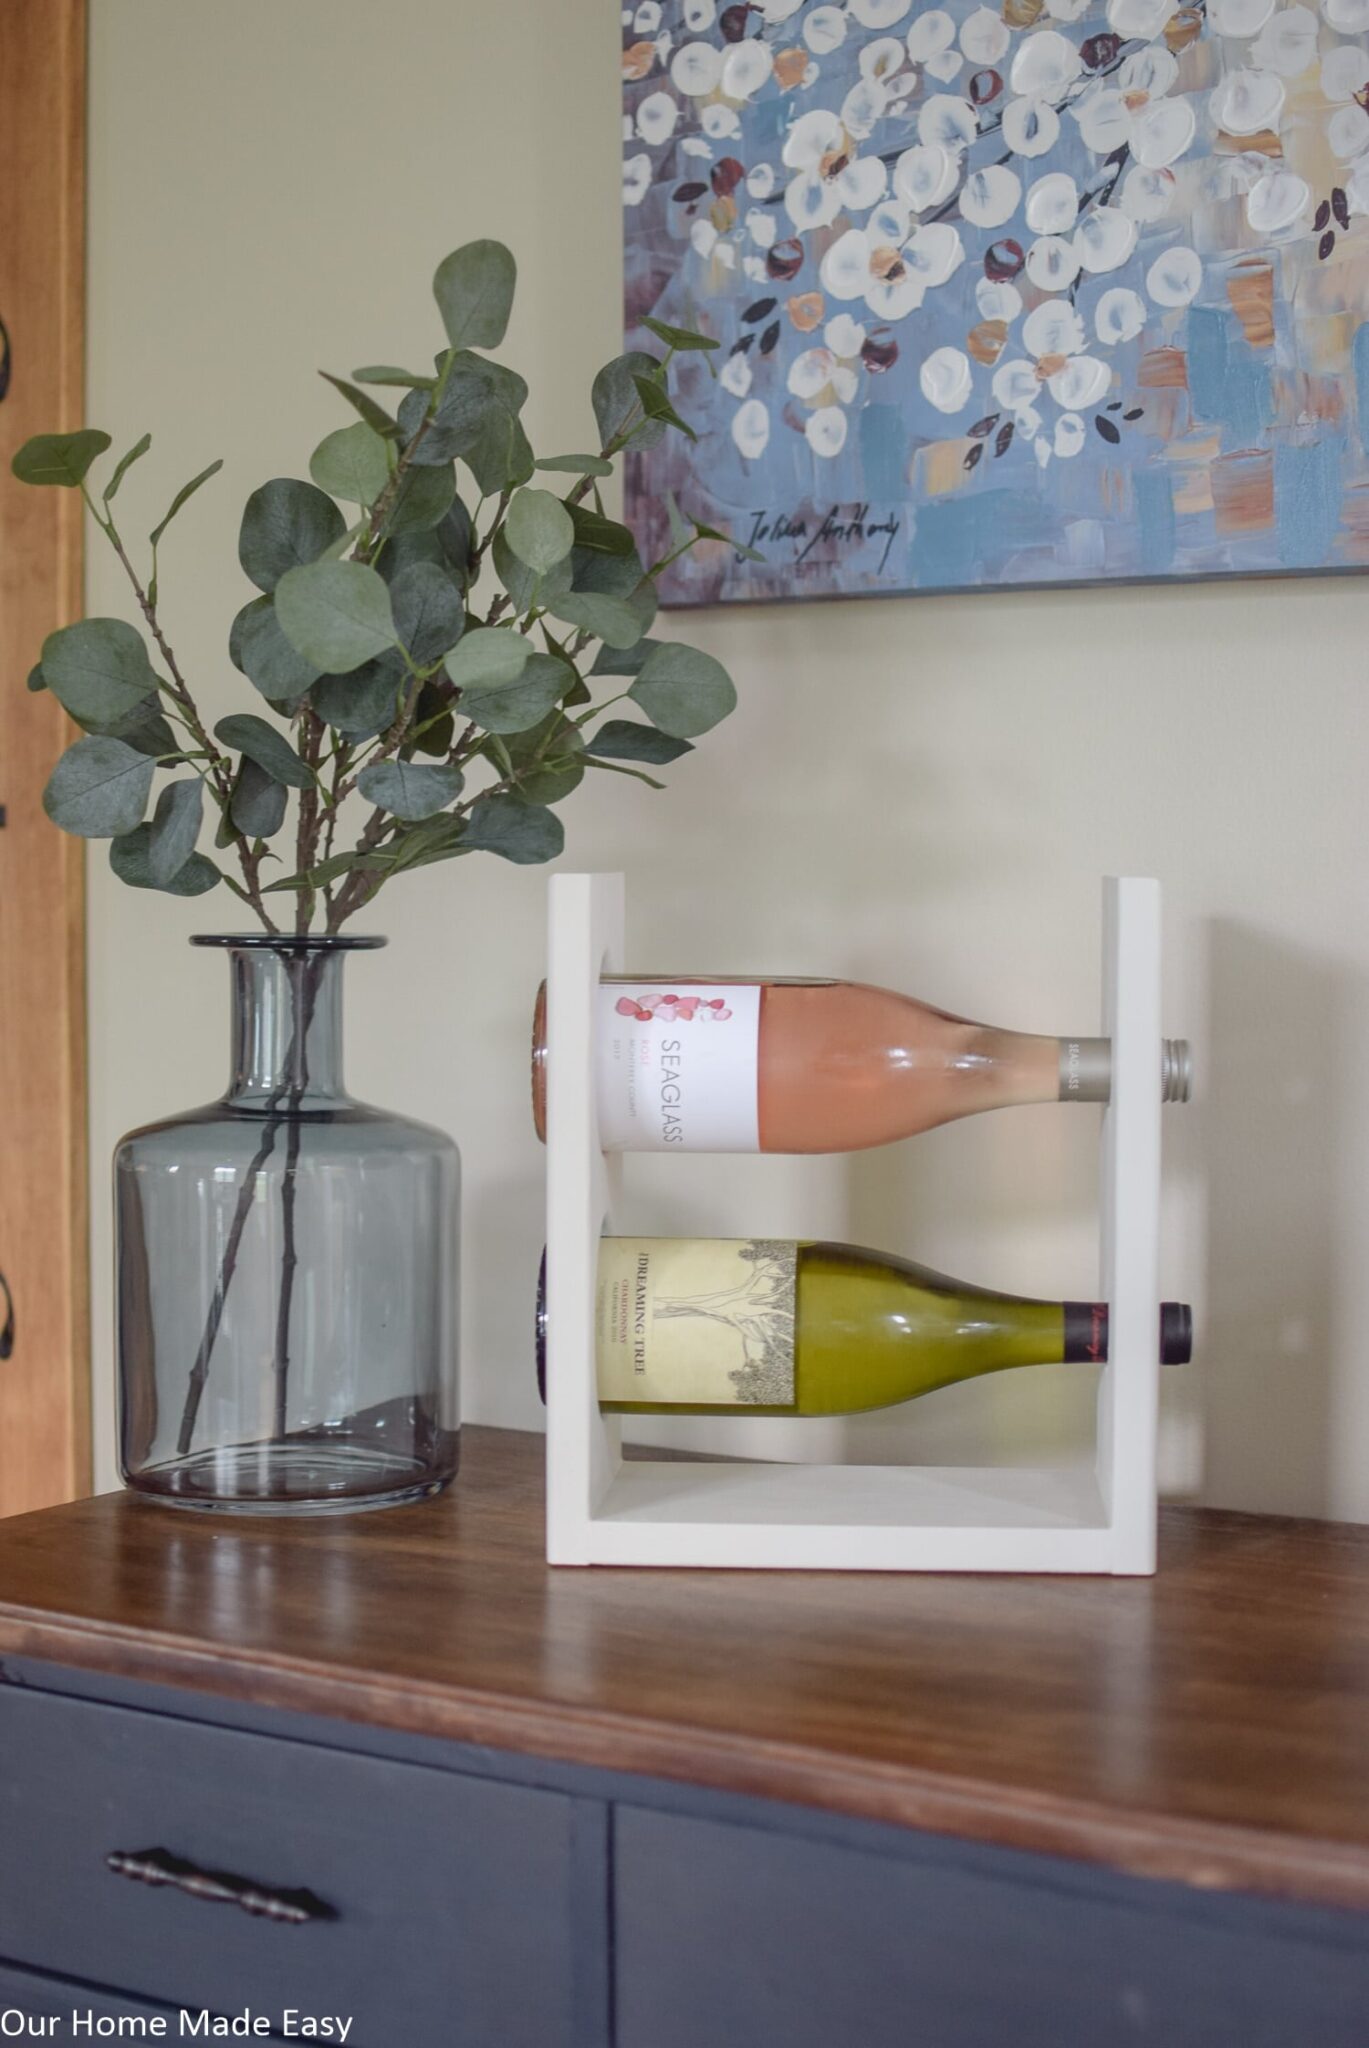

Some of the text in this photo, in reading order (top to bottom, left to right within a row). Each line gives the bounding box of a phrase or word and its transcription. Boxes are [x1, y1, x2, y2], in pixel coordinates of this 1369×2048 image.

[661, 1039, 683, 1143] SEAGLASS
[620, 1278, 629, 1344] CHARDONNAY
[635, 1257, 649, 1335] DREAMING
[634, 1337, 645, 1376] TREE
